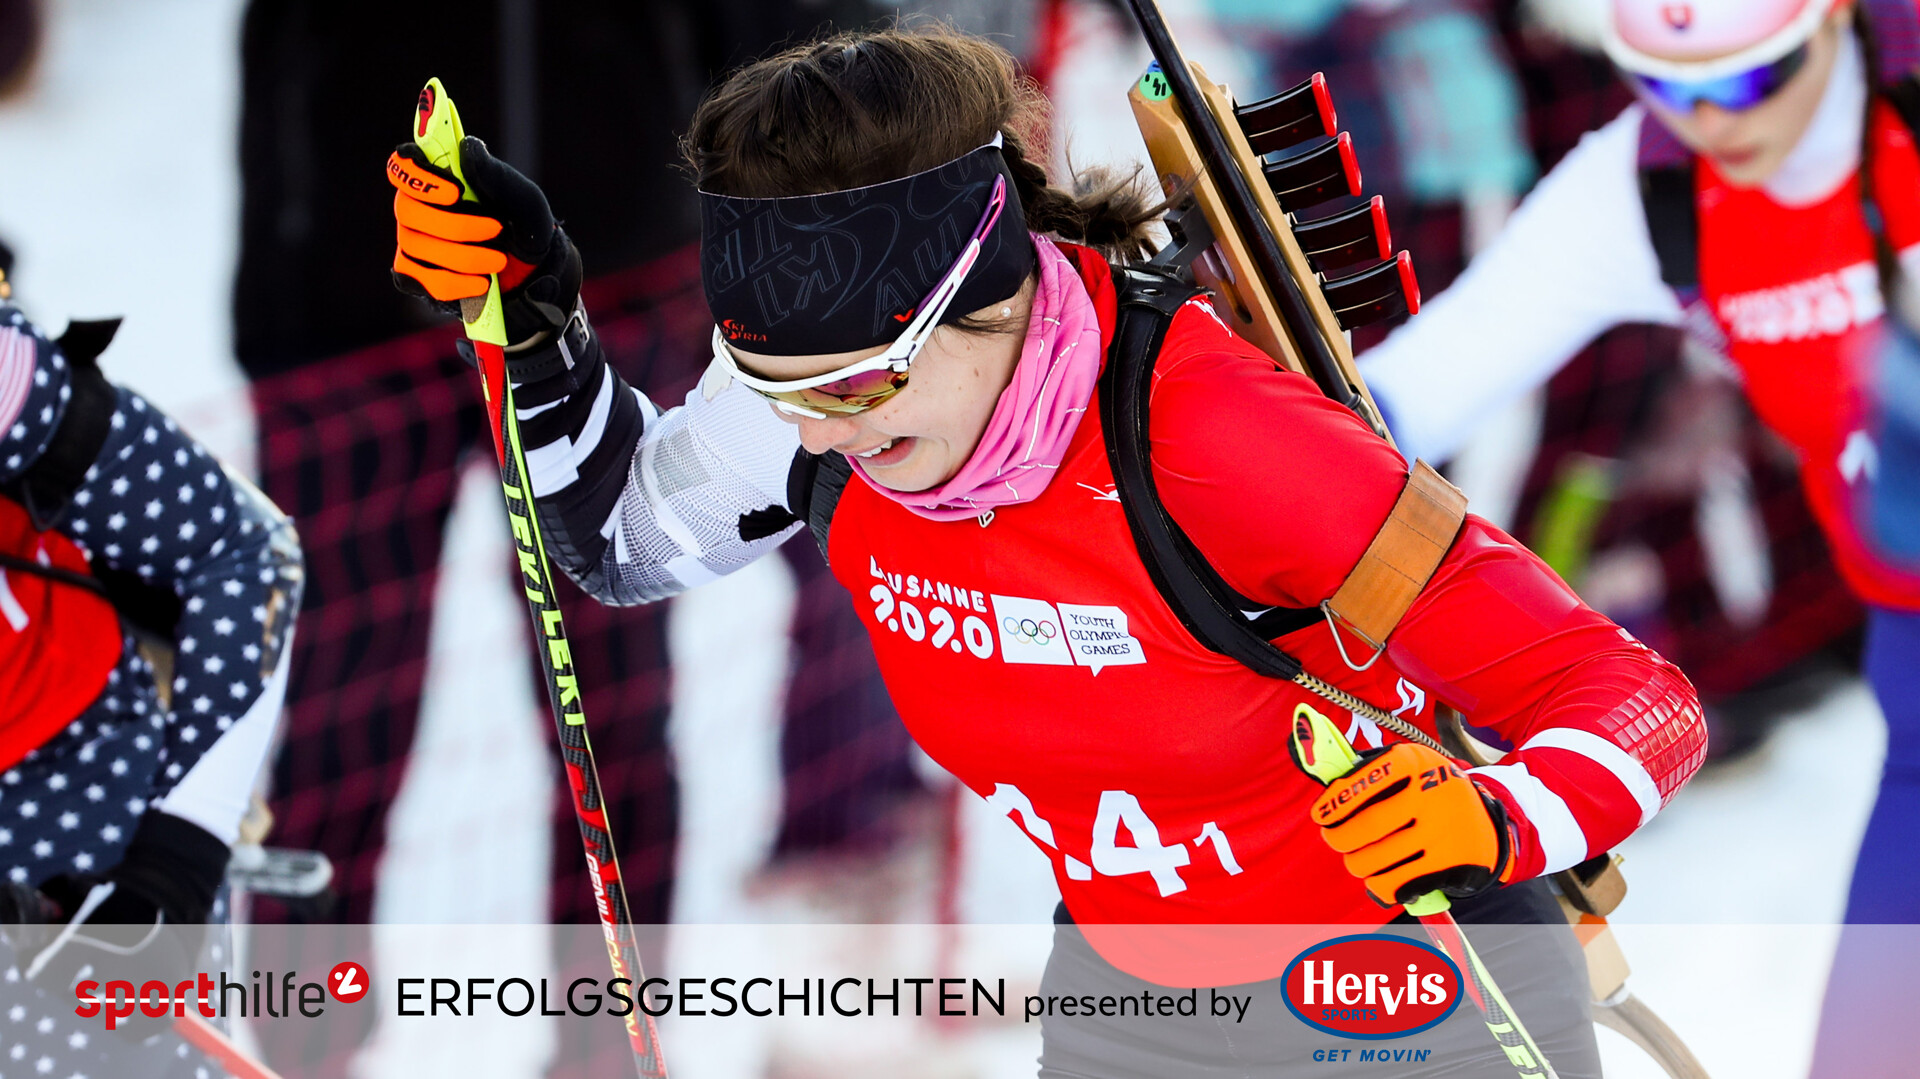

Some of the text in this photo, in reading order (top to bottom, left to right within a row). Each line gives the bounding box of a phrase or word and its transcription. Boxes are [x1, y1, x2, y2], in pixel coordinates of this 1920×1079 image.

[387, 159, 440, 193] iener
[1070, 613, 1115, 629] YOUTH
[1069, 628, 1130, 642] OLYMPIC
[1081, 643, 1131, 656] GAMES
[540, 608, 586, 727] LEKI
[1318, 761, 1393, 819] ziener
